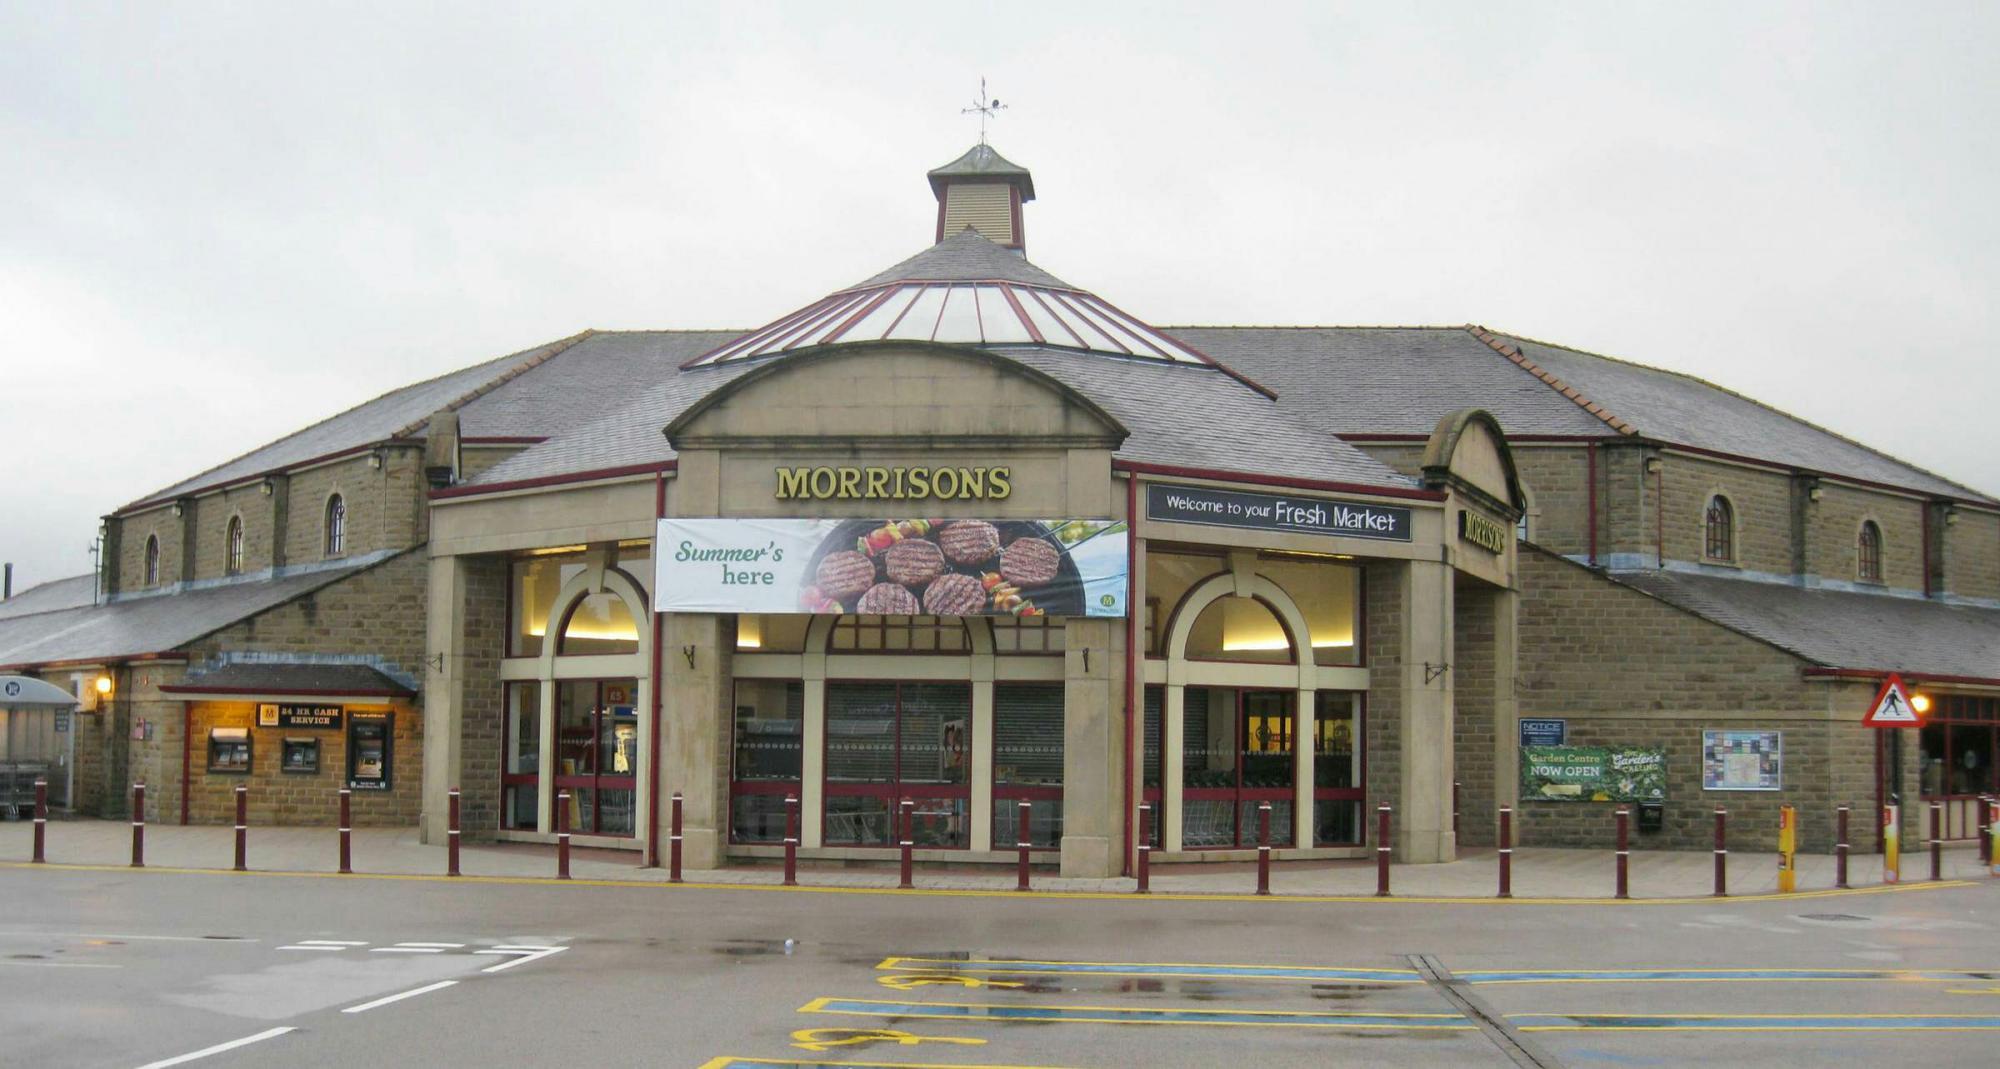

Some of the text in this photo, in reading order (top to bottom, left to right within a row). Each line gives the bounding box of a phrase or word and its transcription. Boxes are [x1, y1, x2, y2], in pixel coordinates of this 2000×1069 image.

[775, 466, 1011, 500] MORRISONS
[1166, 495, 1396, 531] Welcome to your Fresh Market
[675, 540, 784, 562] Summer's
[721, 563, 775, 585] here
[281, 707, 339, 717] 24 HR CASH
[290, 717, 330, 725] SERVICE
[1523, 722, 1561, 731] NOTICE
[1529, 753, 1600, 763] Garden Centre
[1530, 766, 1600, 777] NOW OPEN
